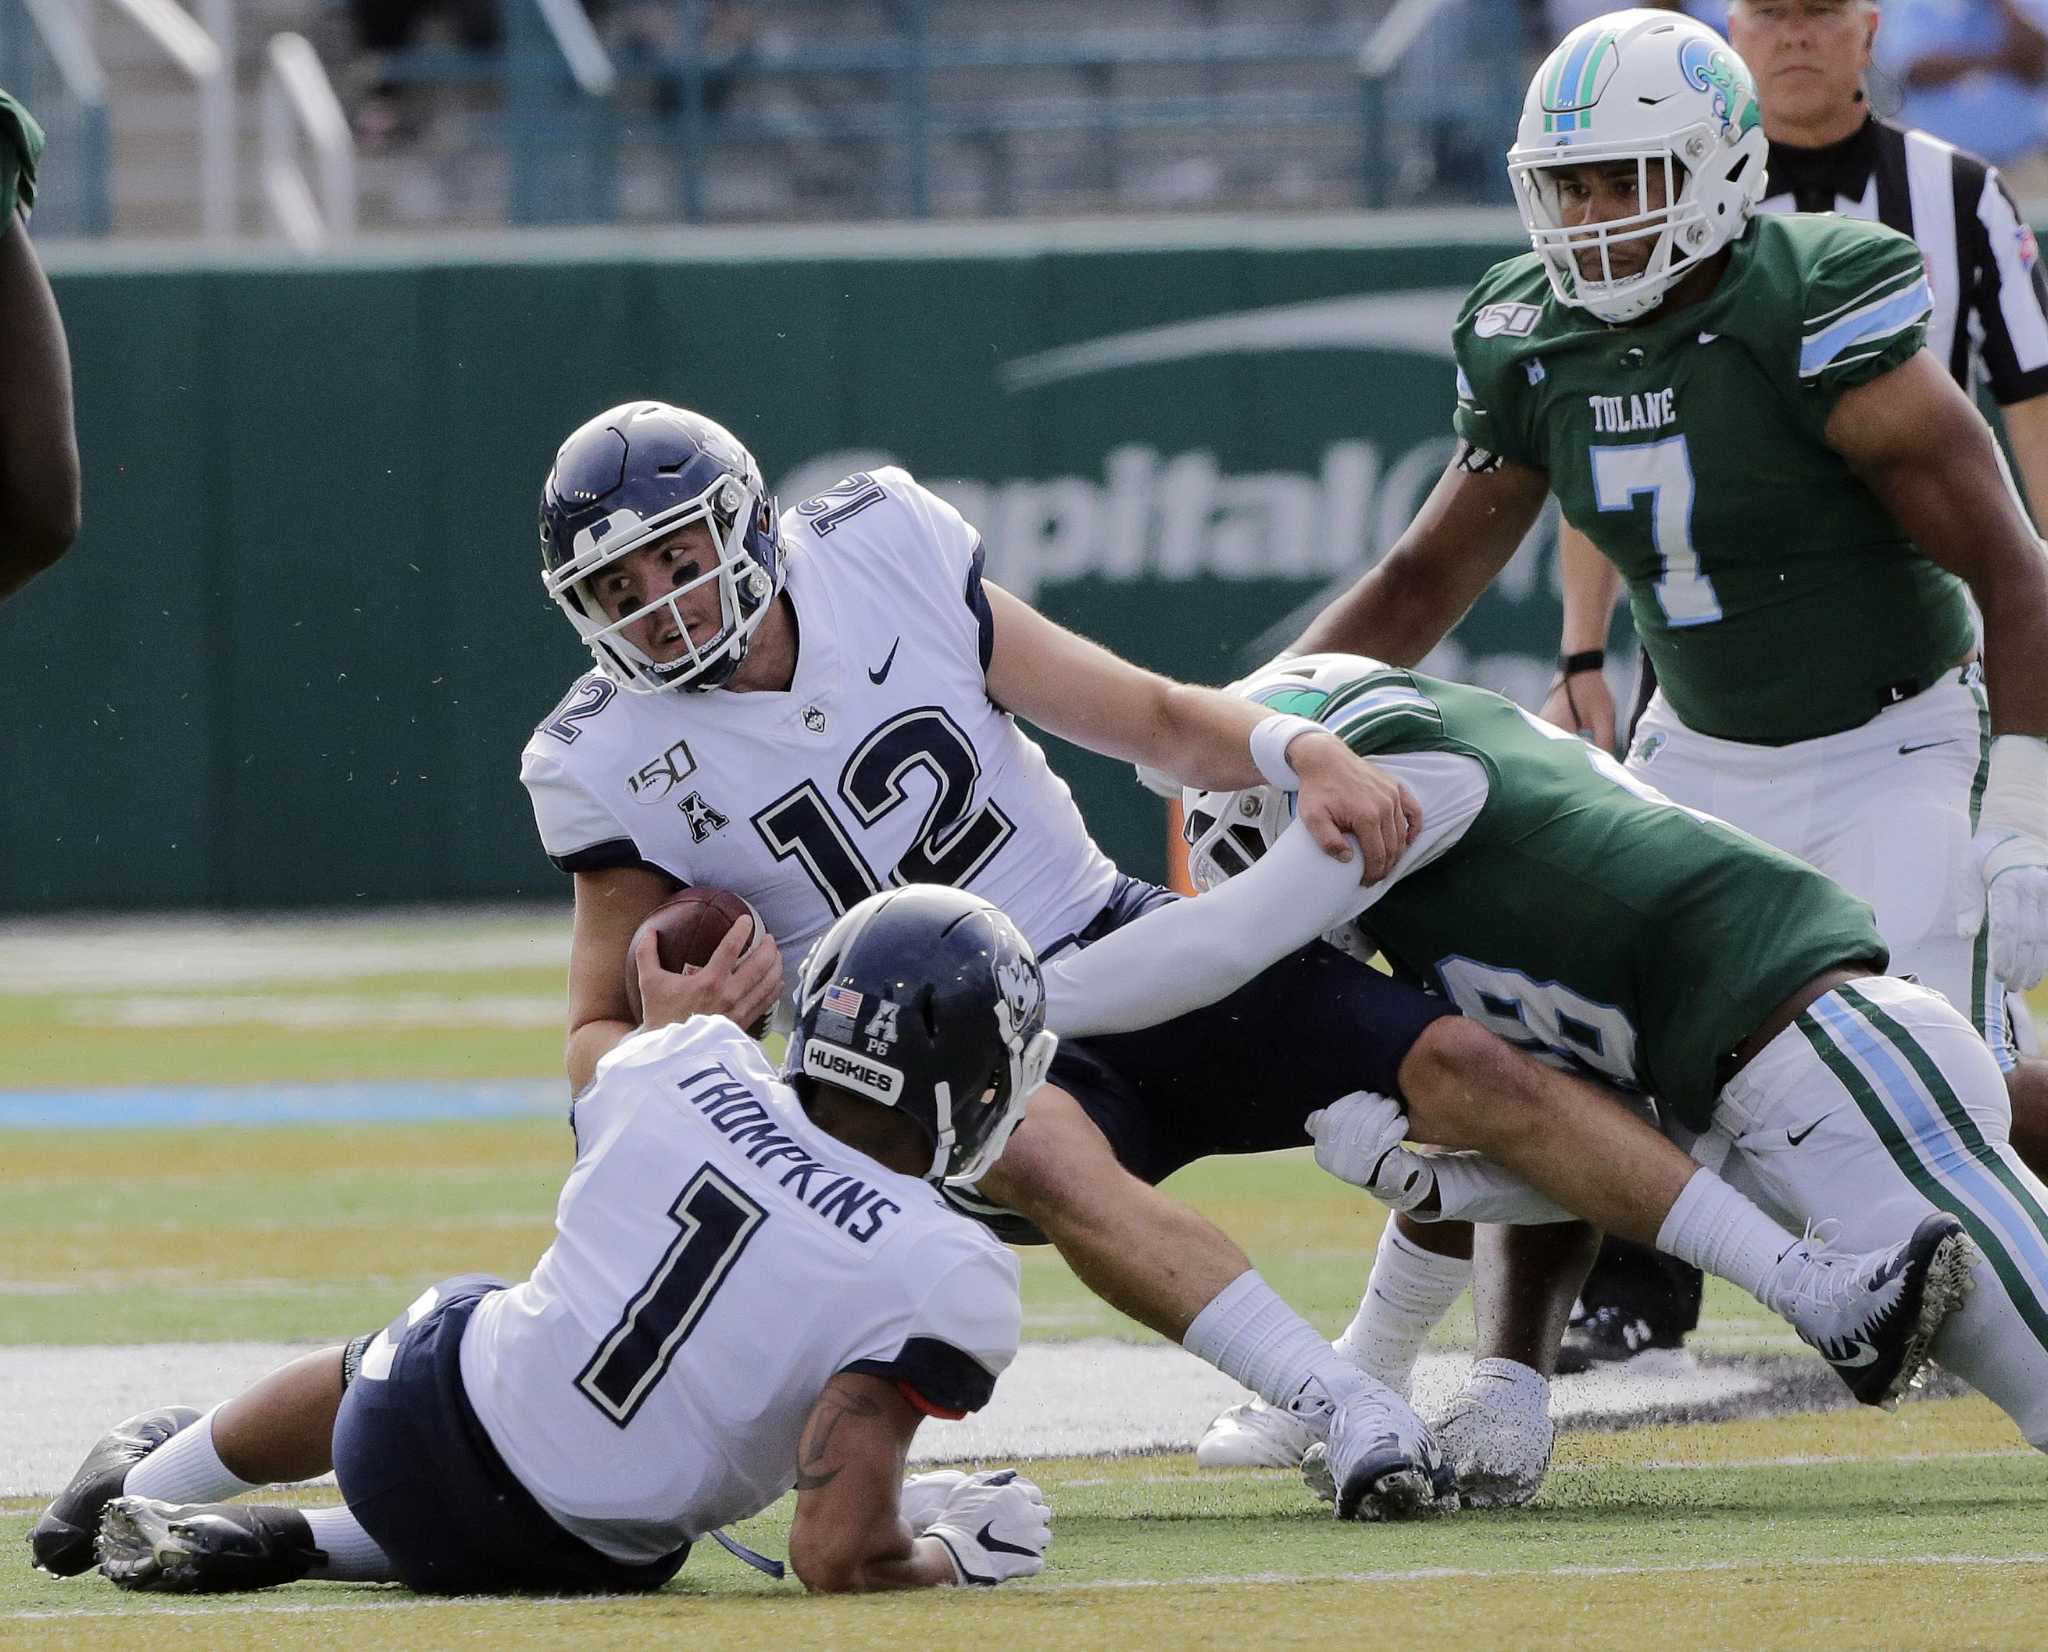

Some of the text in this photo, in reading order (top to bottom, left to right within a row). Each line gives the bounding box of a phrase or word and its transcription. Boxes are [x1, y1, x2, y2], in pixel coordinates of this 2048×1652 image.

[1589, 387, 1677, 433] TULANE
[1589, 432, 1723, 628] 7
[626, 739, 698, 799] 150
[677, 790, 731, 844] A
[750, 705, 1018, 918] 12
[864, 999, 900, 1043] A
[866, 1038, 889, 1056] P6
[807, 1046, 893, 1092] HUSKIES
[677, 1062, 902, 1243] THOMPKINS
[573, 1161, 770, 1429] 1
